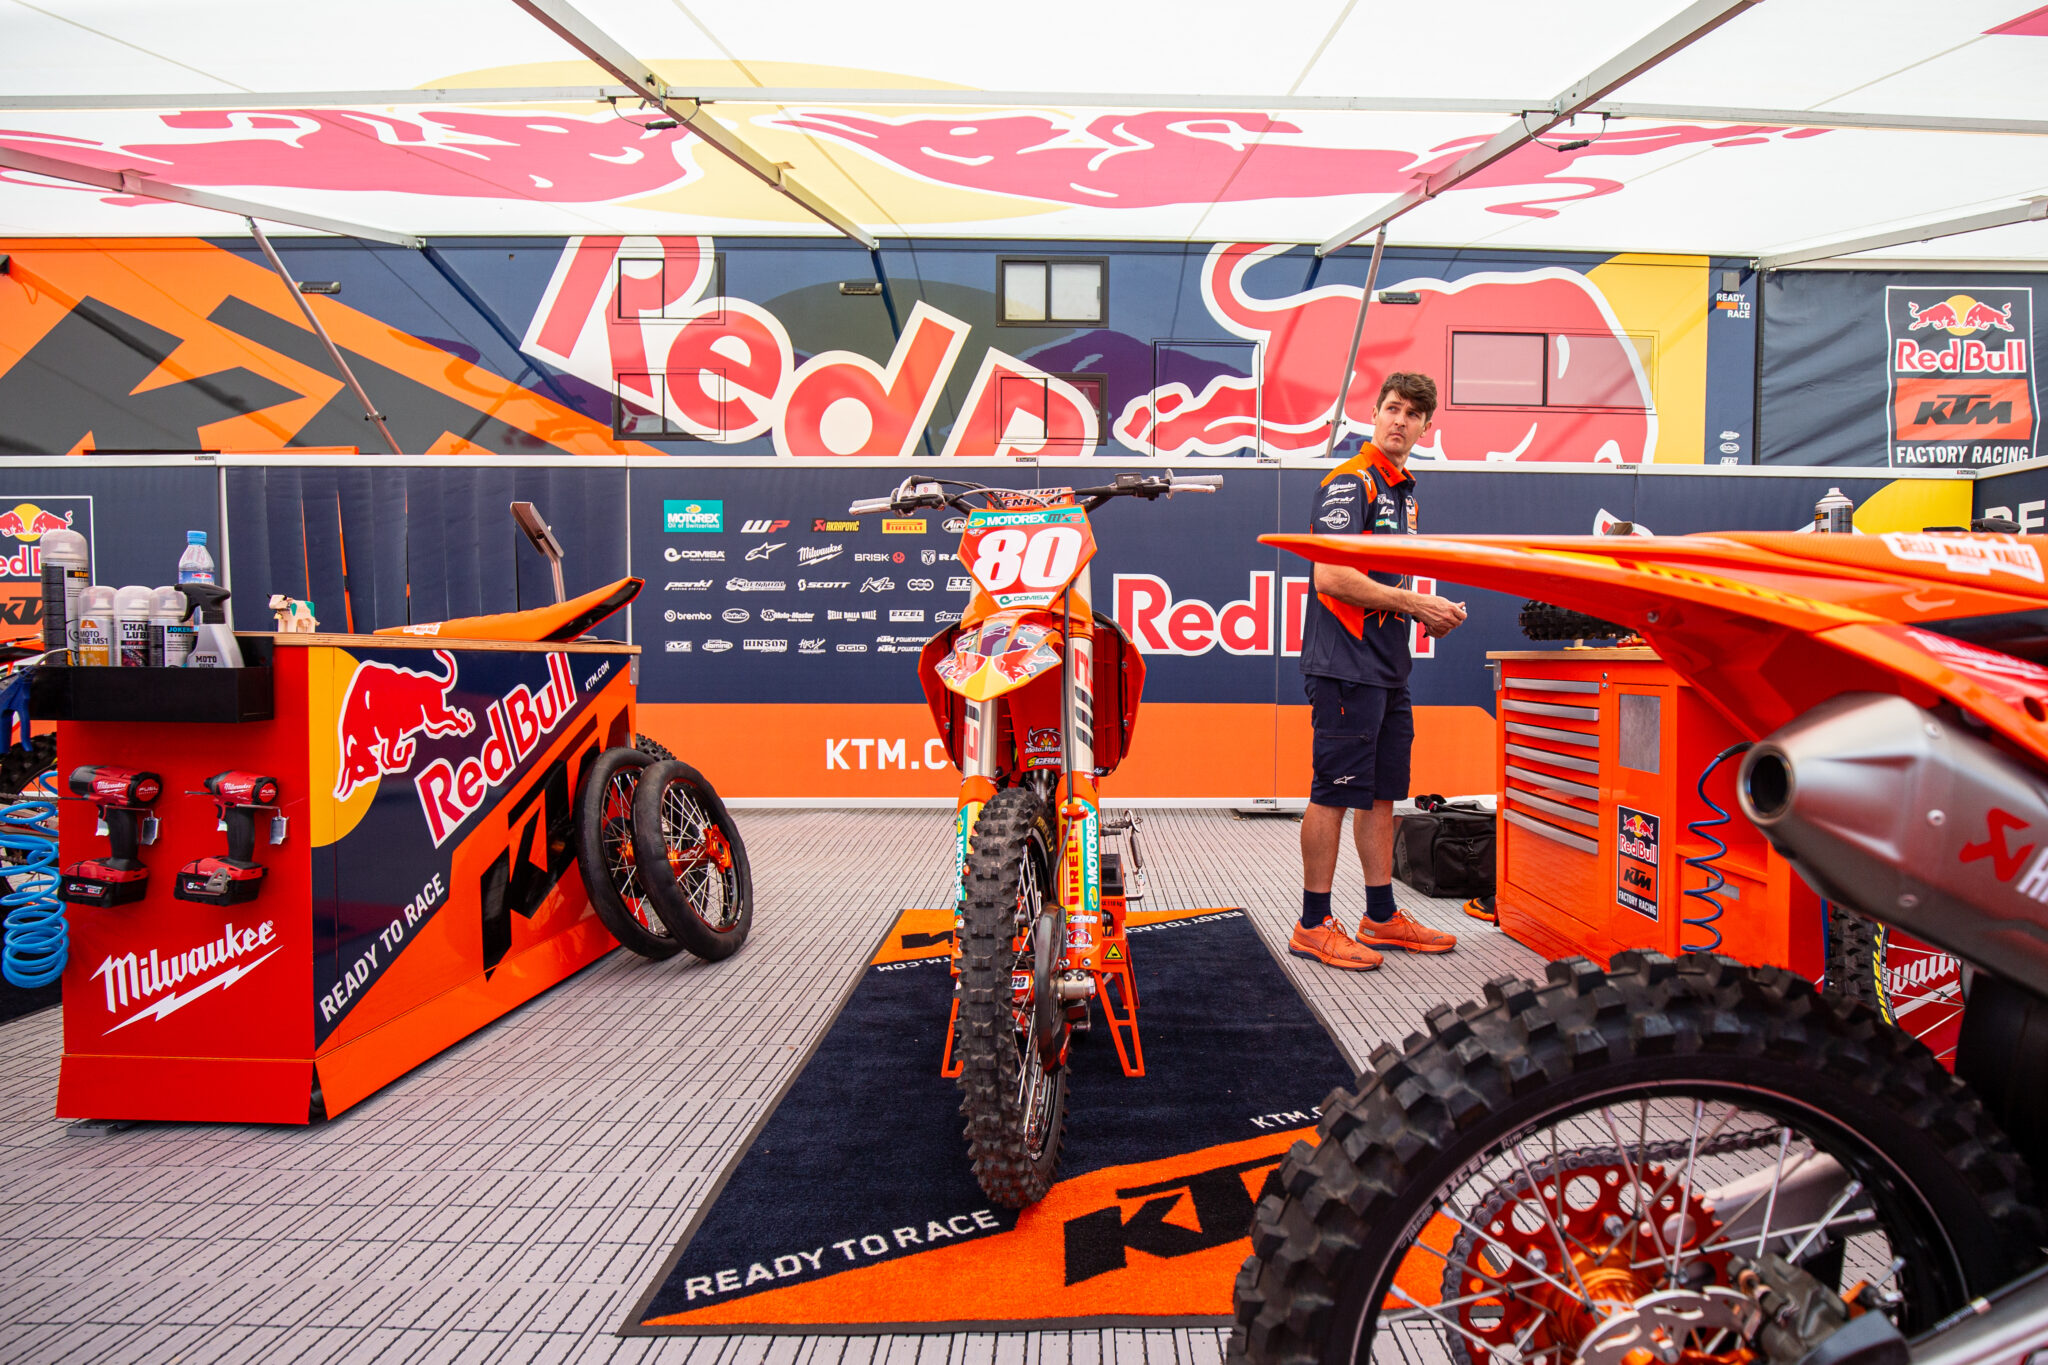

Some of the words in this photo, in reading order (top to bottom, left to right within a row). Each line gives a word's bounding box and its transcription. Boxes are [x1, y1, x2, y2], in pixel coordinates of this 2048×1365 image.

[1716, 293, 1745, 302] READY
[1739, 302, 1750, 310] TO
[1727, 310, 1750, 318] RACE
[521, 236, 972, 456] Red
[1896, 339, 1961, 372] Red
[1962, 339, 2026, 373] Bull
[1913, 394, 2013, 425] KTM
[1896, 446, 1967, 463] FACTORY
[1972, 446, 2029, 464] RACING
[668, 513, 720, 523] MOTOREX
[886, 522, 923, 531] PIRELLI
[987, 513, 1047, 526] MOTOREX
[0, 545, 30, 577] ed
[972, 527, 1083, 592] 80
[1013, 594, 1050, 602] COMISA
[123, 623, 149, 631] CHAI
[677, 612, 711, 620] brembo
[935, 611, 963, 622] SCRU
[1116, 571, 1274, 656] Red
[585, 661, 610, 691] KTM.COM
[414, 700, 515, 849] Red
[503, 653, 578, 764] Bull
[826, 738, 956, 770] KTM.C
[1028, 757, 1062, 768] SCRU
[1086, 811, 1098, 885] MOTOREX
[1619, 833, 1638, 857] Red
[1637, 840, 1657, 864] Bull
[956, 836, 965, 908] MOTORE
[1624, 867, 1651, 891] KTM
[1619, 891, 1638, 907] FACTORY
[319, 949, 379, 1022] READY
[379, 922, 404, 953] TO
[403, 872, 446, 927] RACE
[89, 922, 278, 1014] Milwaukee
[876, 956, 951, 972] TM.COM
[1249, 1106, 1323, 1129] KTM.
[1437, 1153, 1493, 1201] EXCEL
[1064, 1153, 1286, 1287] KT
[684, 1247, 823, 1301] READY
[832, 1234, 889, 1261] TO
[893, 1208, 1000, 1249] RACE
